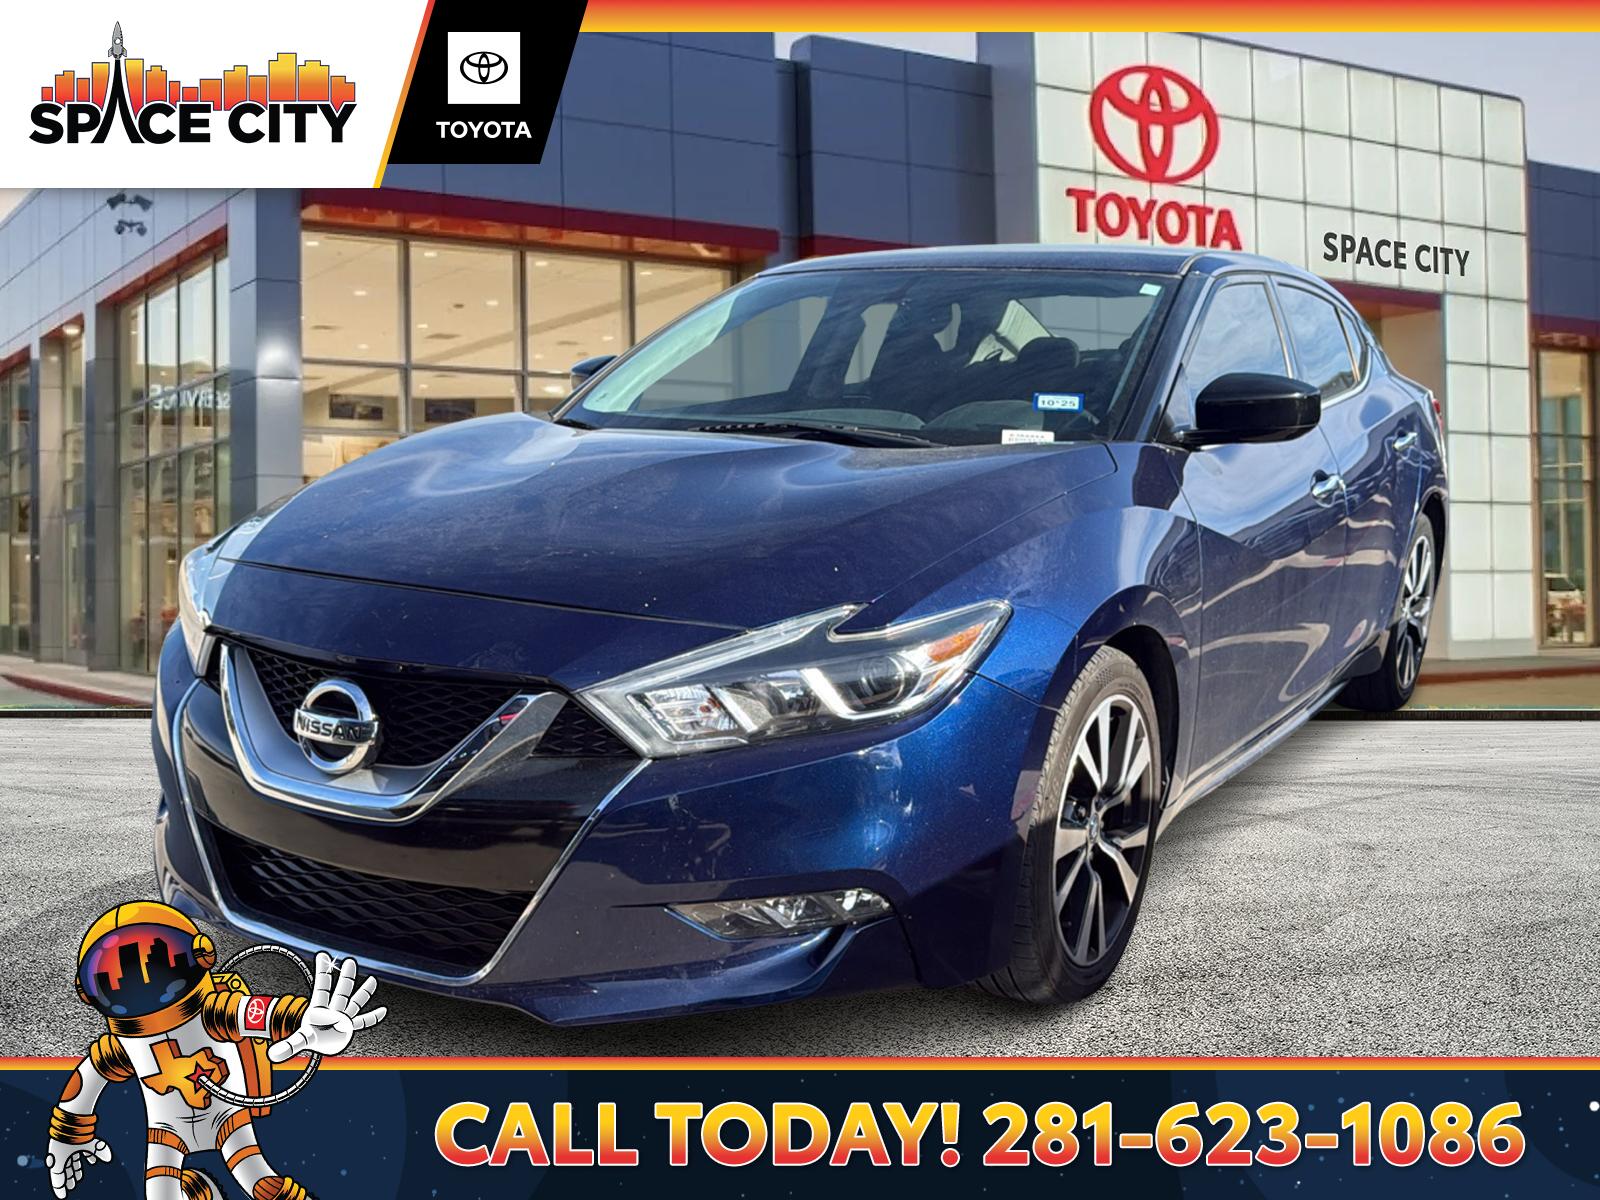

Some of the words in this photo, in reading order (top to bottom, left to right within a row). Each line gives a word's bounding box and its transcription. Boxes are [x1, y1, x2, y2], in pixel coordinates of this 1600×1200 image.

[1066, 187, 1243, 250] TOYOTA
[1322, 231, 1407, 270] SPACE
[1414, 243, 1470, 277] CITY
[297, 712, 361, 740] NISSAN
